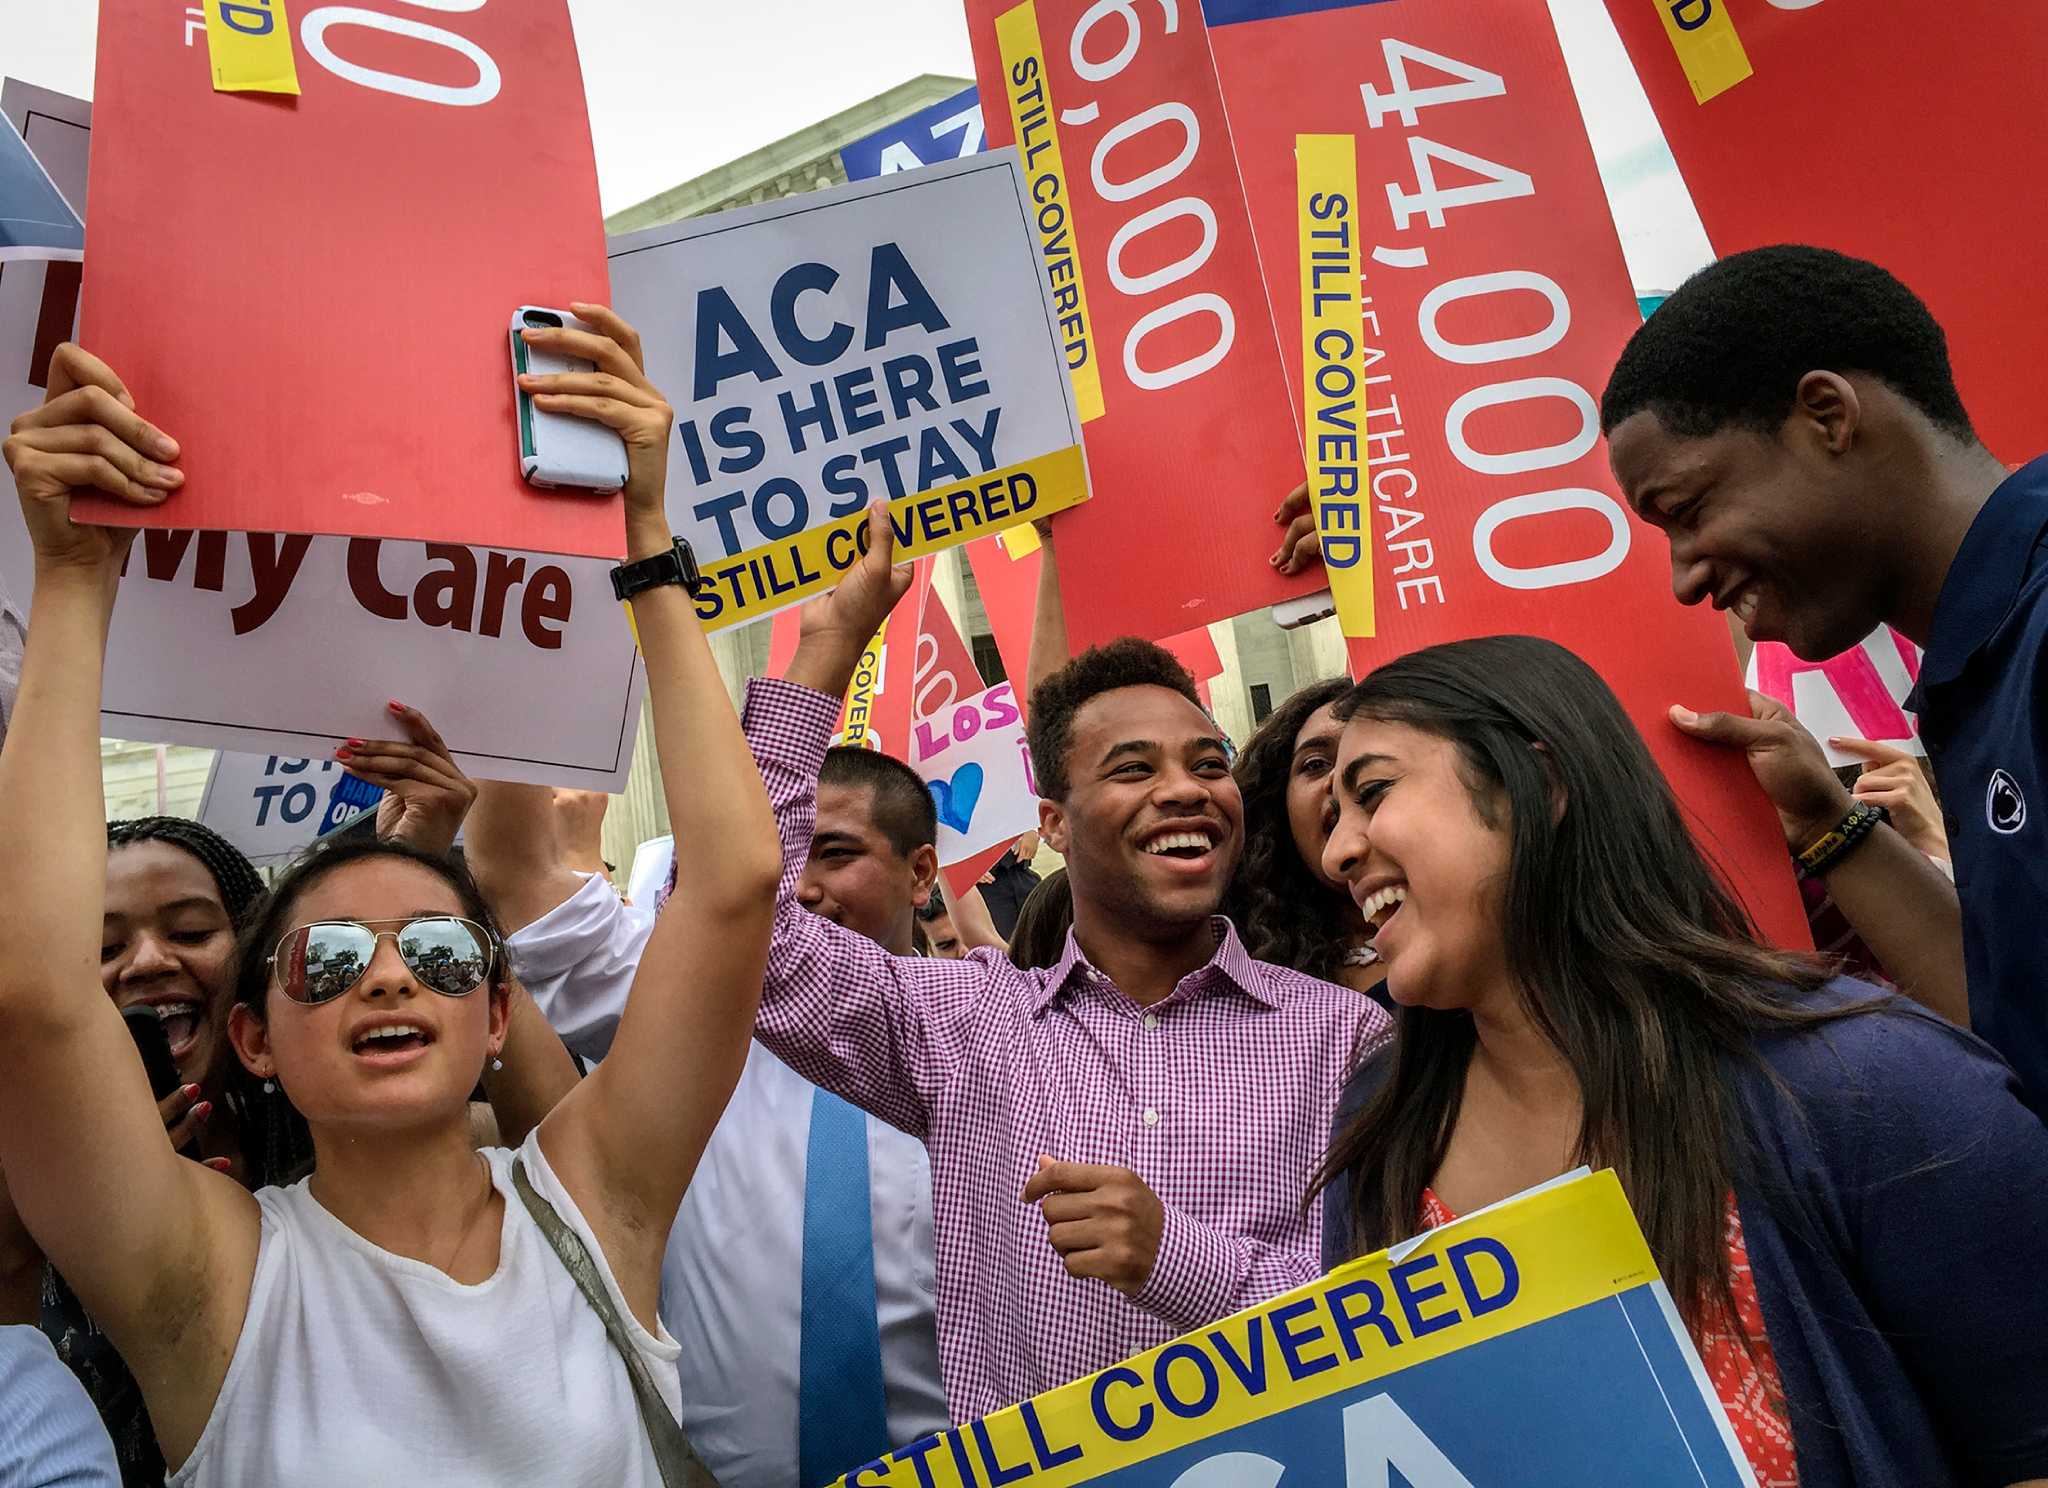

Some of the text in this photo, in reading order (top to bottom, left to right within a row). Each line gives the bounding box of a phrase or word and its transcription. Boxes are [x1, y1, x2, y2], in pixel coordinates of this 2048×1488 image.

[218, 0, 274, 35] D
[300, 0, 501, 106] 0
[1664, 0, 1712, 31] D
[1011, 55, 1088, 371] STILL COVERED
[693, 242, 951, 402] ACA
[1308, 193, 1362, 569] STILL COVERED
[1360, 38, 1632, 590] 44,000
[678, 337, 991, 485] IS HERE
[692, 407, 1003, 557] TO STAY
[1360, 274, 1446, 611] THCARE
[120, 528, 573, 649] My Care
[695, 545, 821, 620] STILL
[848, 651, 876, 749] COVER
[253, 782, 316, 827] TO
[1090, 1237, 1520, 1442] COVERED
